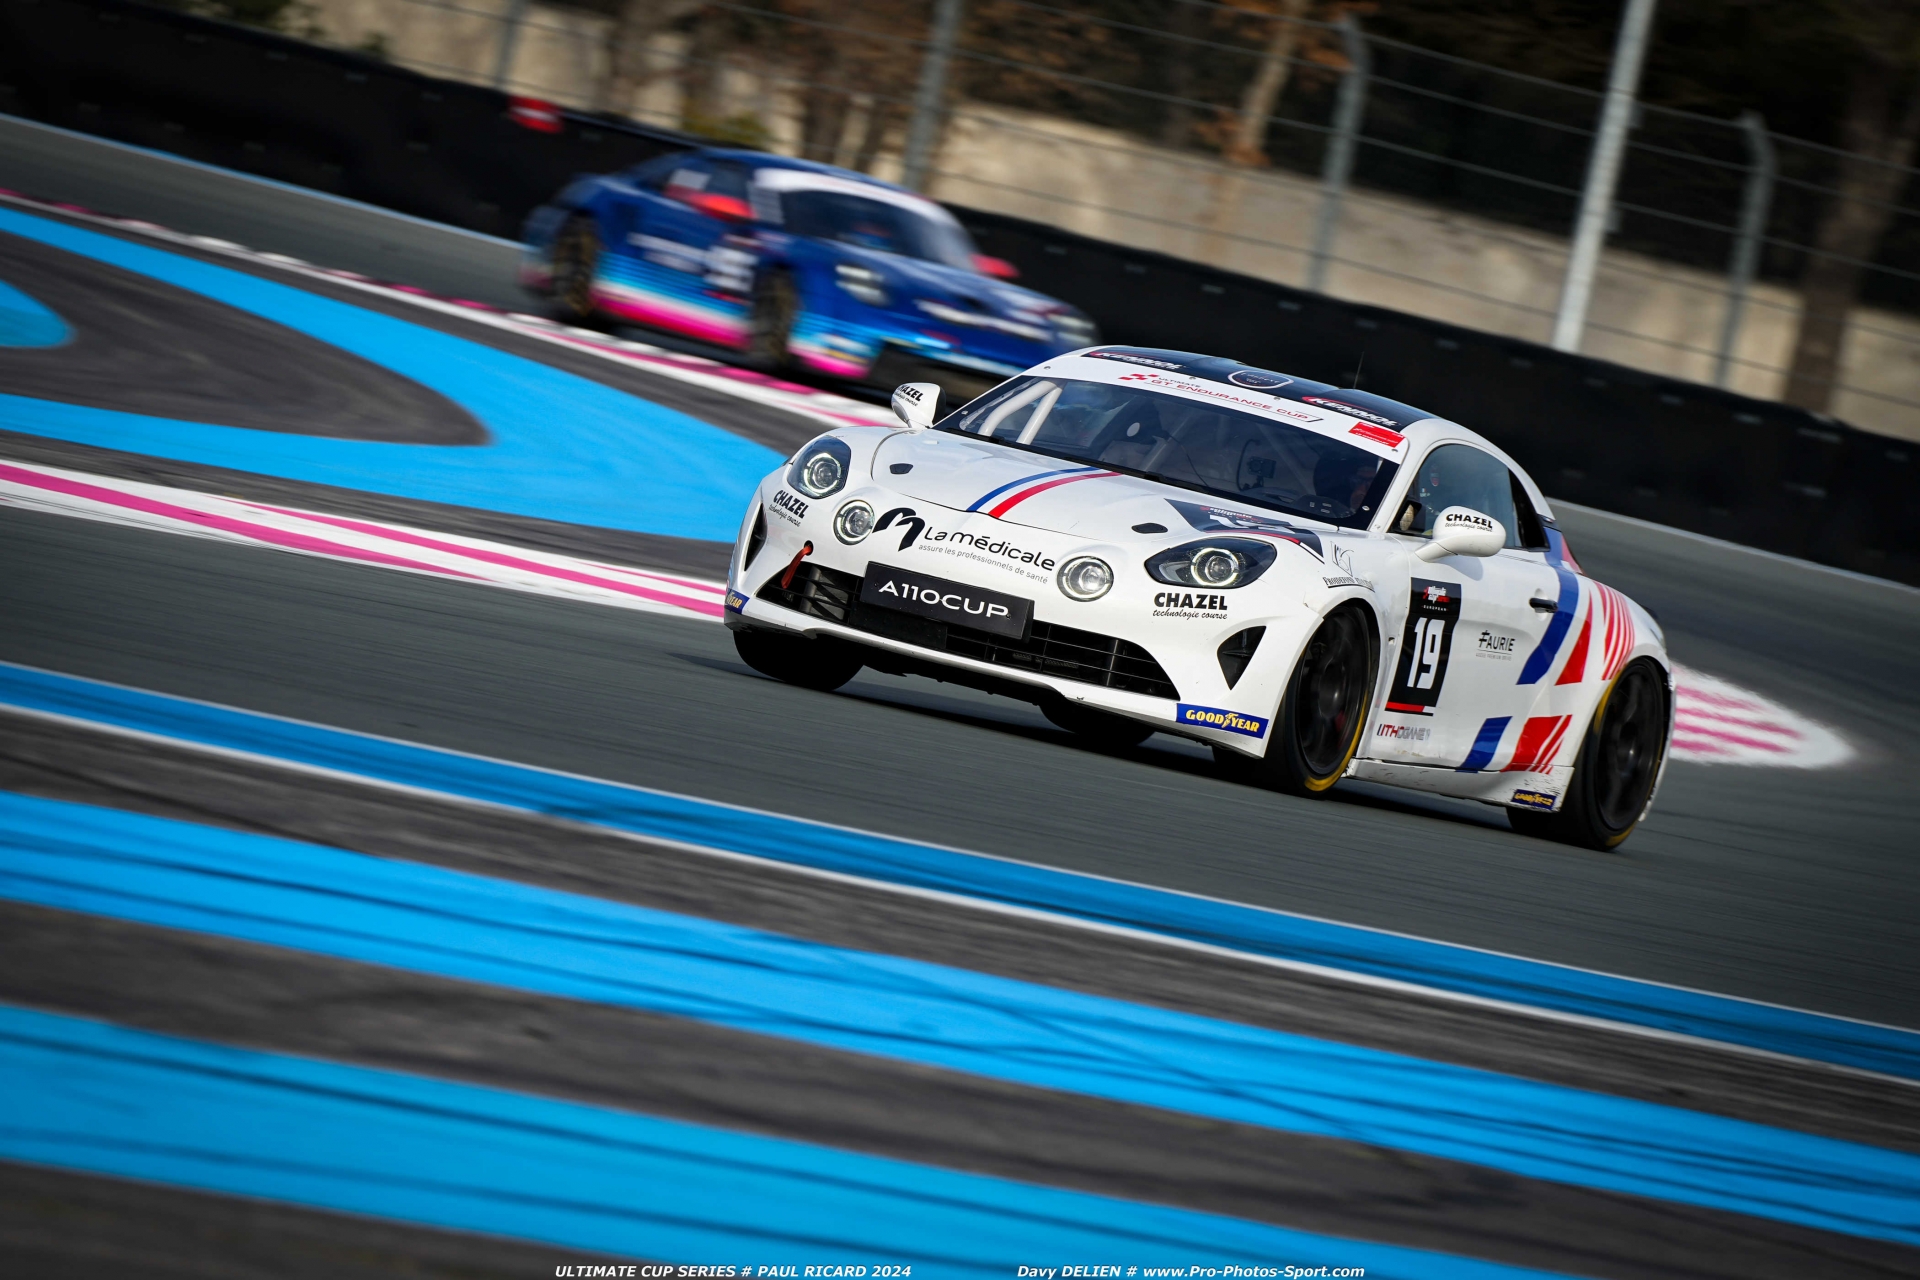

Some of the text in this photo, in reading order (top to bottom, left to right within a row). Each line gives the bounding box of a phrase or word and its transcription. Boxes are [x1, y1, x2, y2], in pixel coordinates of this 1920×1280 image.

[1176, 384, 1273, 410] ENDURANCE
[1276, 407, 1310, 420] CUP
[773, 489, 809, 519] CHAZEL
[1446, 513, 1493, 529] CHAZEL
[949, 531, 1055, 571] médicale
[918, 544, 1049, 585] assure les professionnels de santé
[1152, 608, 1199, 620] technologie
[1154, 592, 1228, 610] CHAZEL
[1407, 617, 1446, 690] 19
[1478, 630, 1516, 651] FAURIE
[1186, 710, 1260, 732] GOODYEAR
